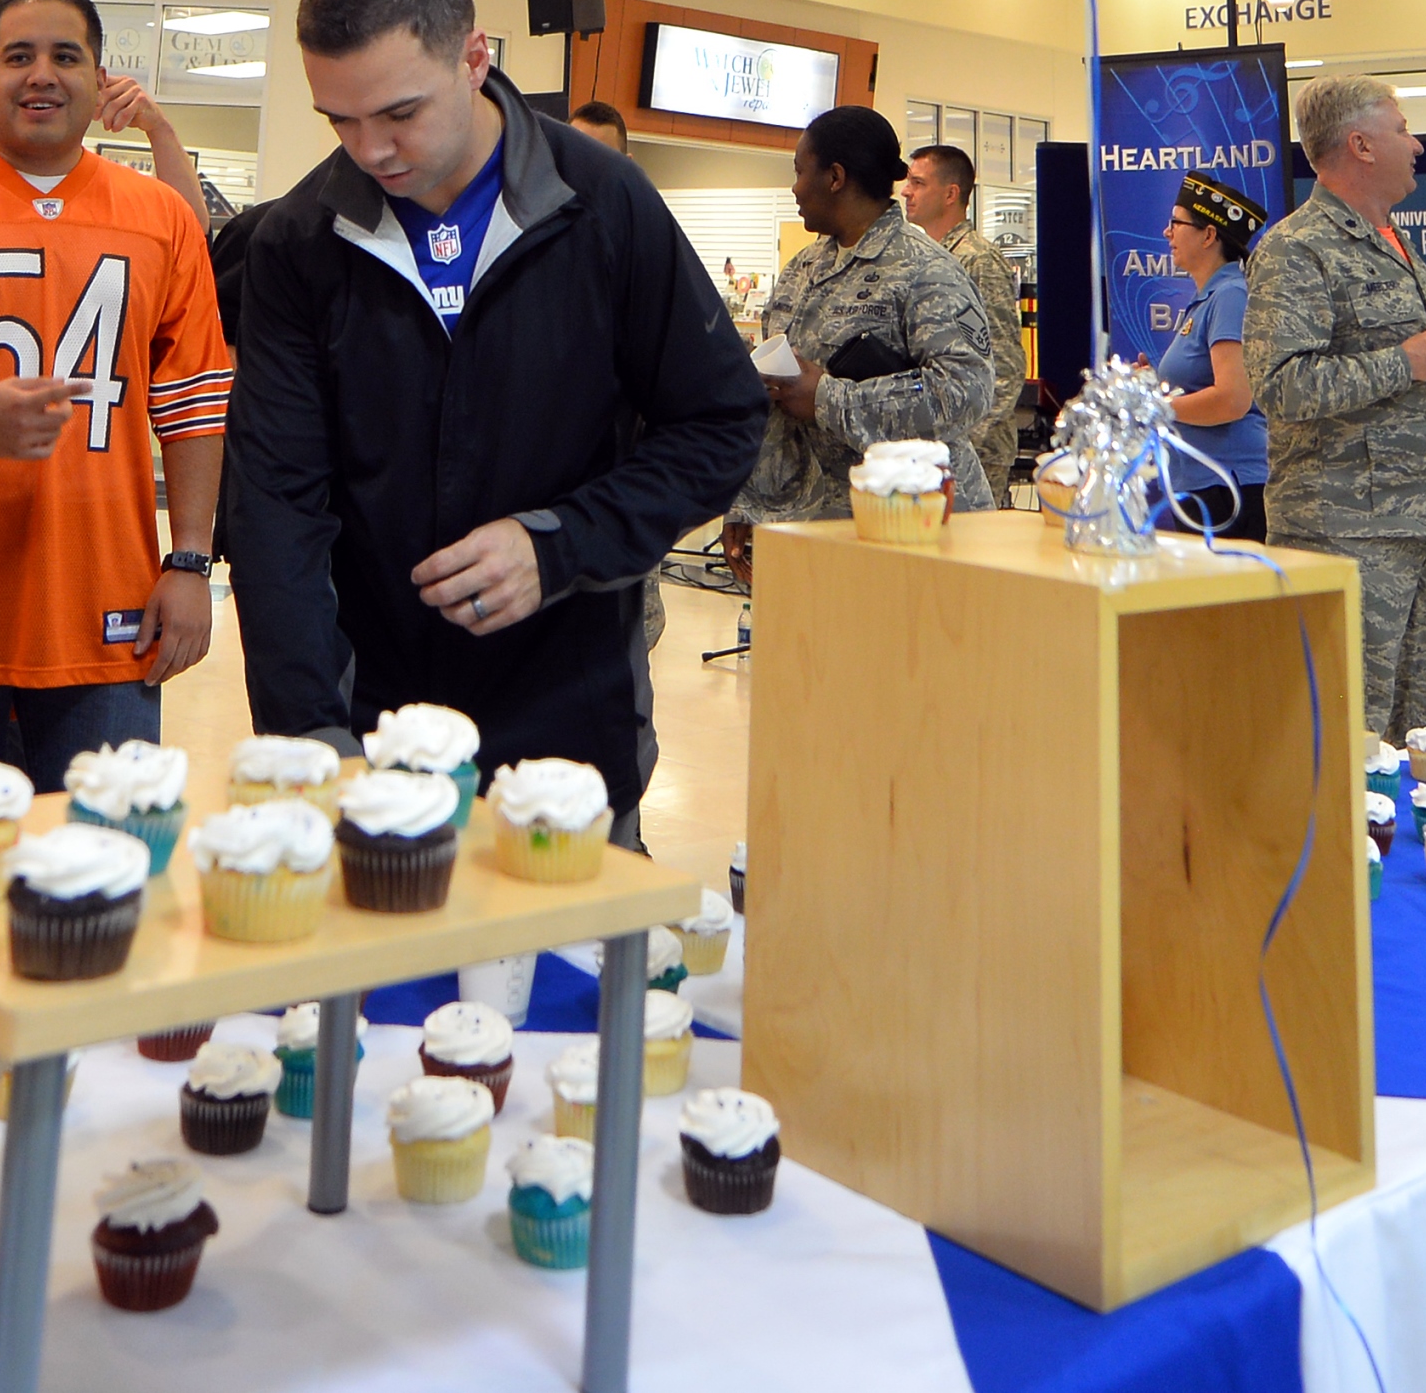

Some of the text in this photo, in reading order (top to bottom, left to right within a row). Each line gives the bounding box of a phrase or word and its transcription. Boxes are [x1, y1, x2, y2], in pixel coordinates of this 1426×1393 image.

[1100, 139, 1276, 172] HEARTLAND
[1192, 202, 1228, 227] NEBRASKA
[435, 240, 457, 257] NFL
